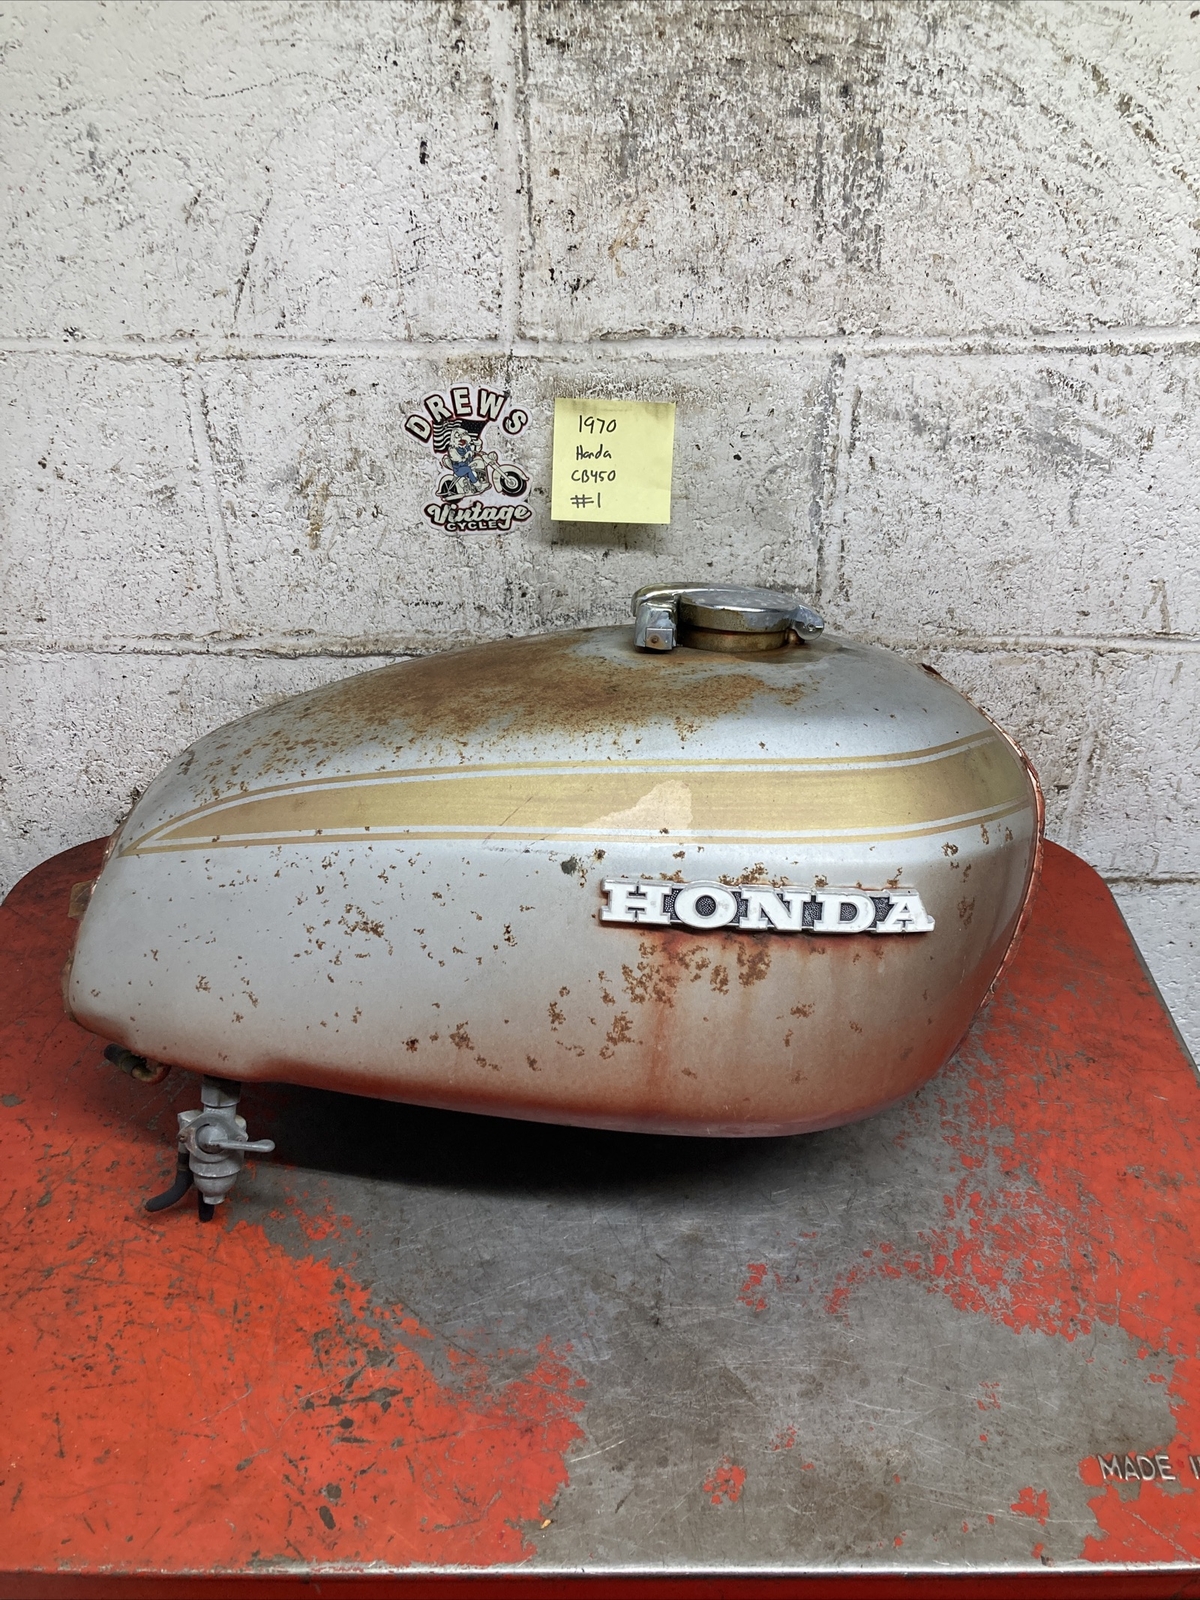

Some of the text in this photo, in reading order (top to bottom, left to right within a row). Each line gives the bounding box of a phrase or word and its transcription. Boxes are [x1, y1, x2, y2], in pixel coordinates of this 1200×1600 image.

[578, 414, 617, 435] 1970
[570, 469, 616, 484] CB450
[569, 491, 601, 509] #1
[425, 501, 532, 530] Vintage
[601, 878, 935, 933] HONDA
[1097, 1454, 1200, 1481] MADE I
